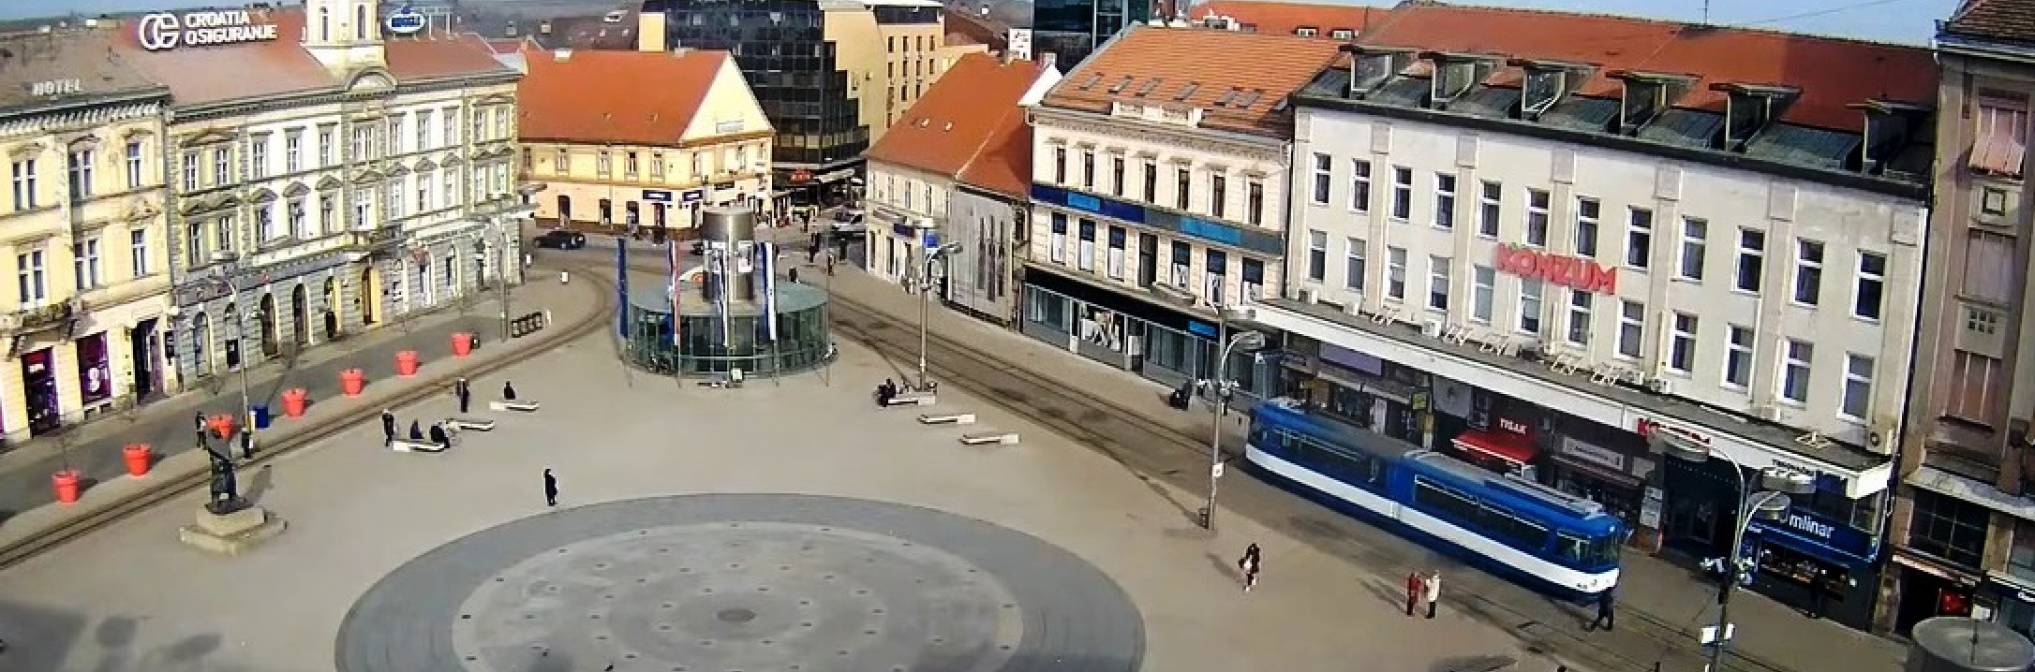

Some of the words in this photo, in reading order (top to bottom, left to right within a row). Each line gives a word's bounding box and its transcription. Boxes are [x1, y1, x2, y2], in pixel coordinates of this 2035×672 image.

[184, 10, 251, 27] CROATIA
[31, 79, 80, 96] HOTEL
[1496, 241, 1617, 296] KONZUM
[1788, 513, 1836, 539] mlinar
